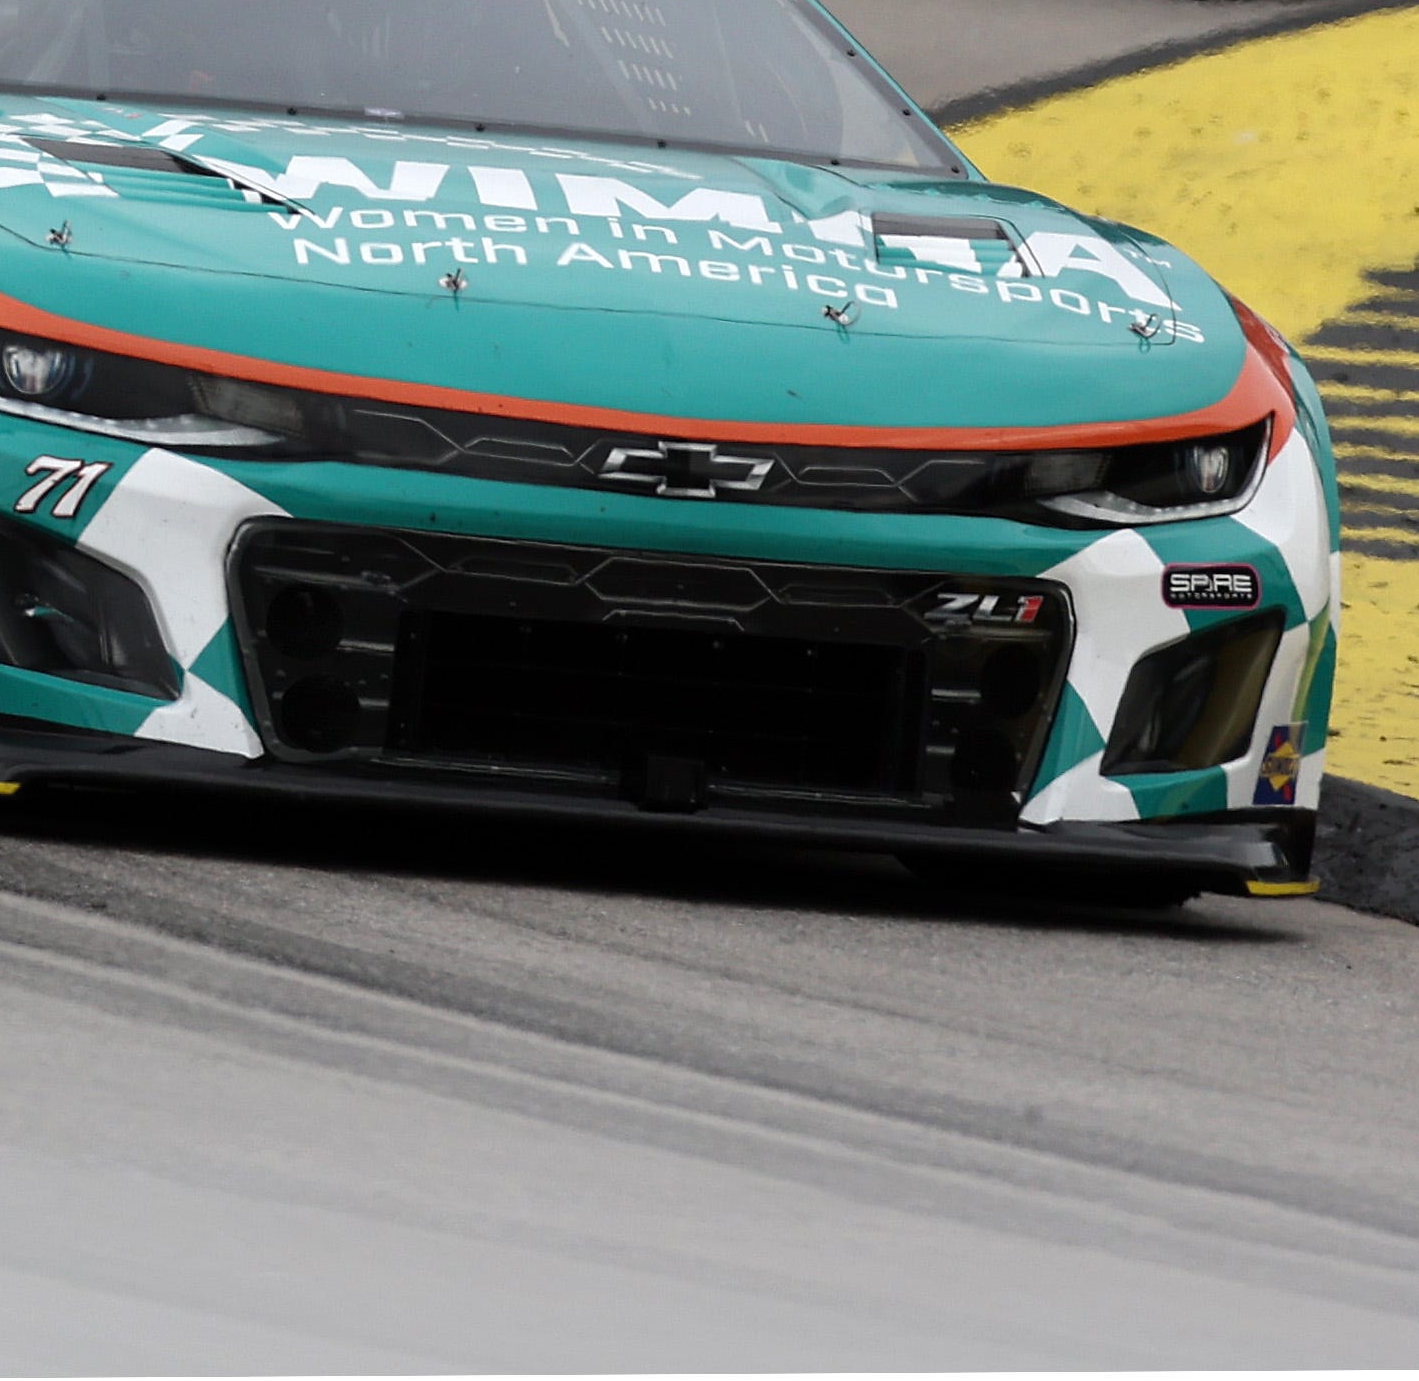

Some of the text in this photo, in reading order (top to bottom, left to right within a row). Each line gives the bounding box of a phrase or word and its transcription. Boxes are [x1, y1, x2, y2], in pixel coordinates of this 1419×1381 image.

[267, 205, 582, 235] Women
[607, 216, 678, 245] in
[292, 235, 899, 310] North America
[13, 453, 110, 519] 71
[923, 592, 1044, 623] ZL1
